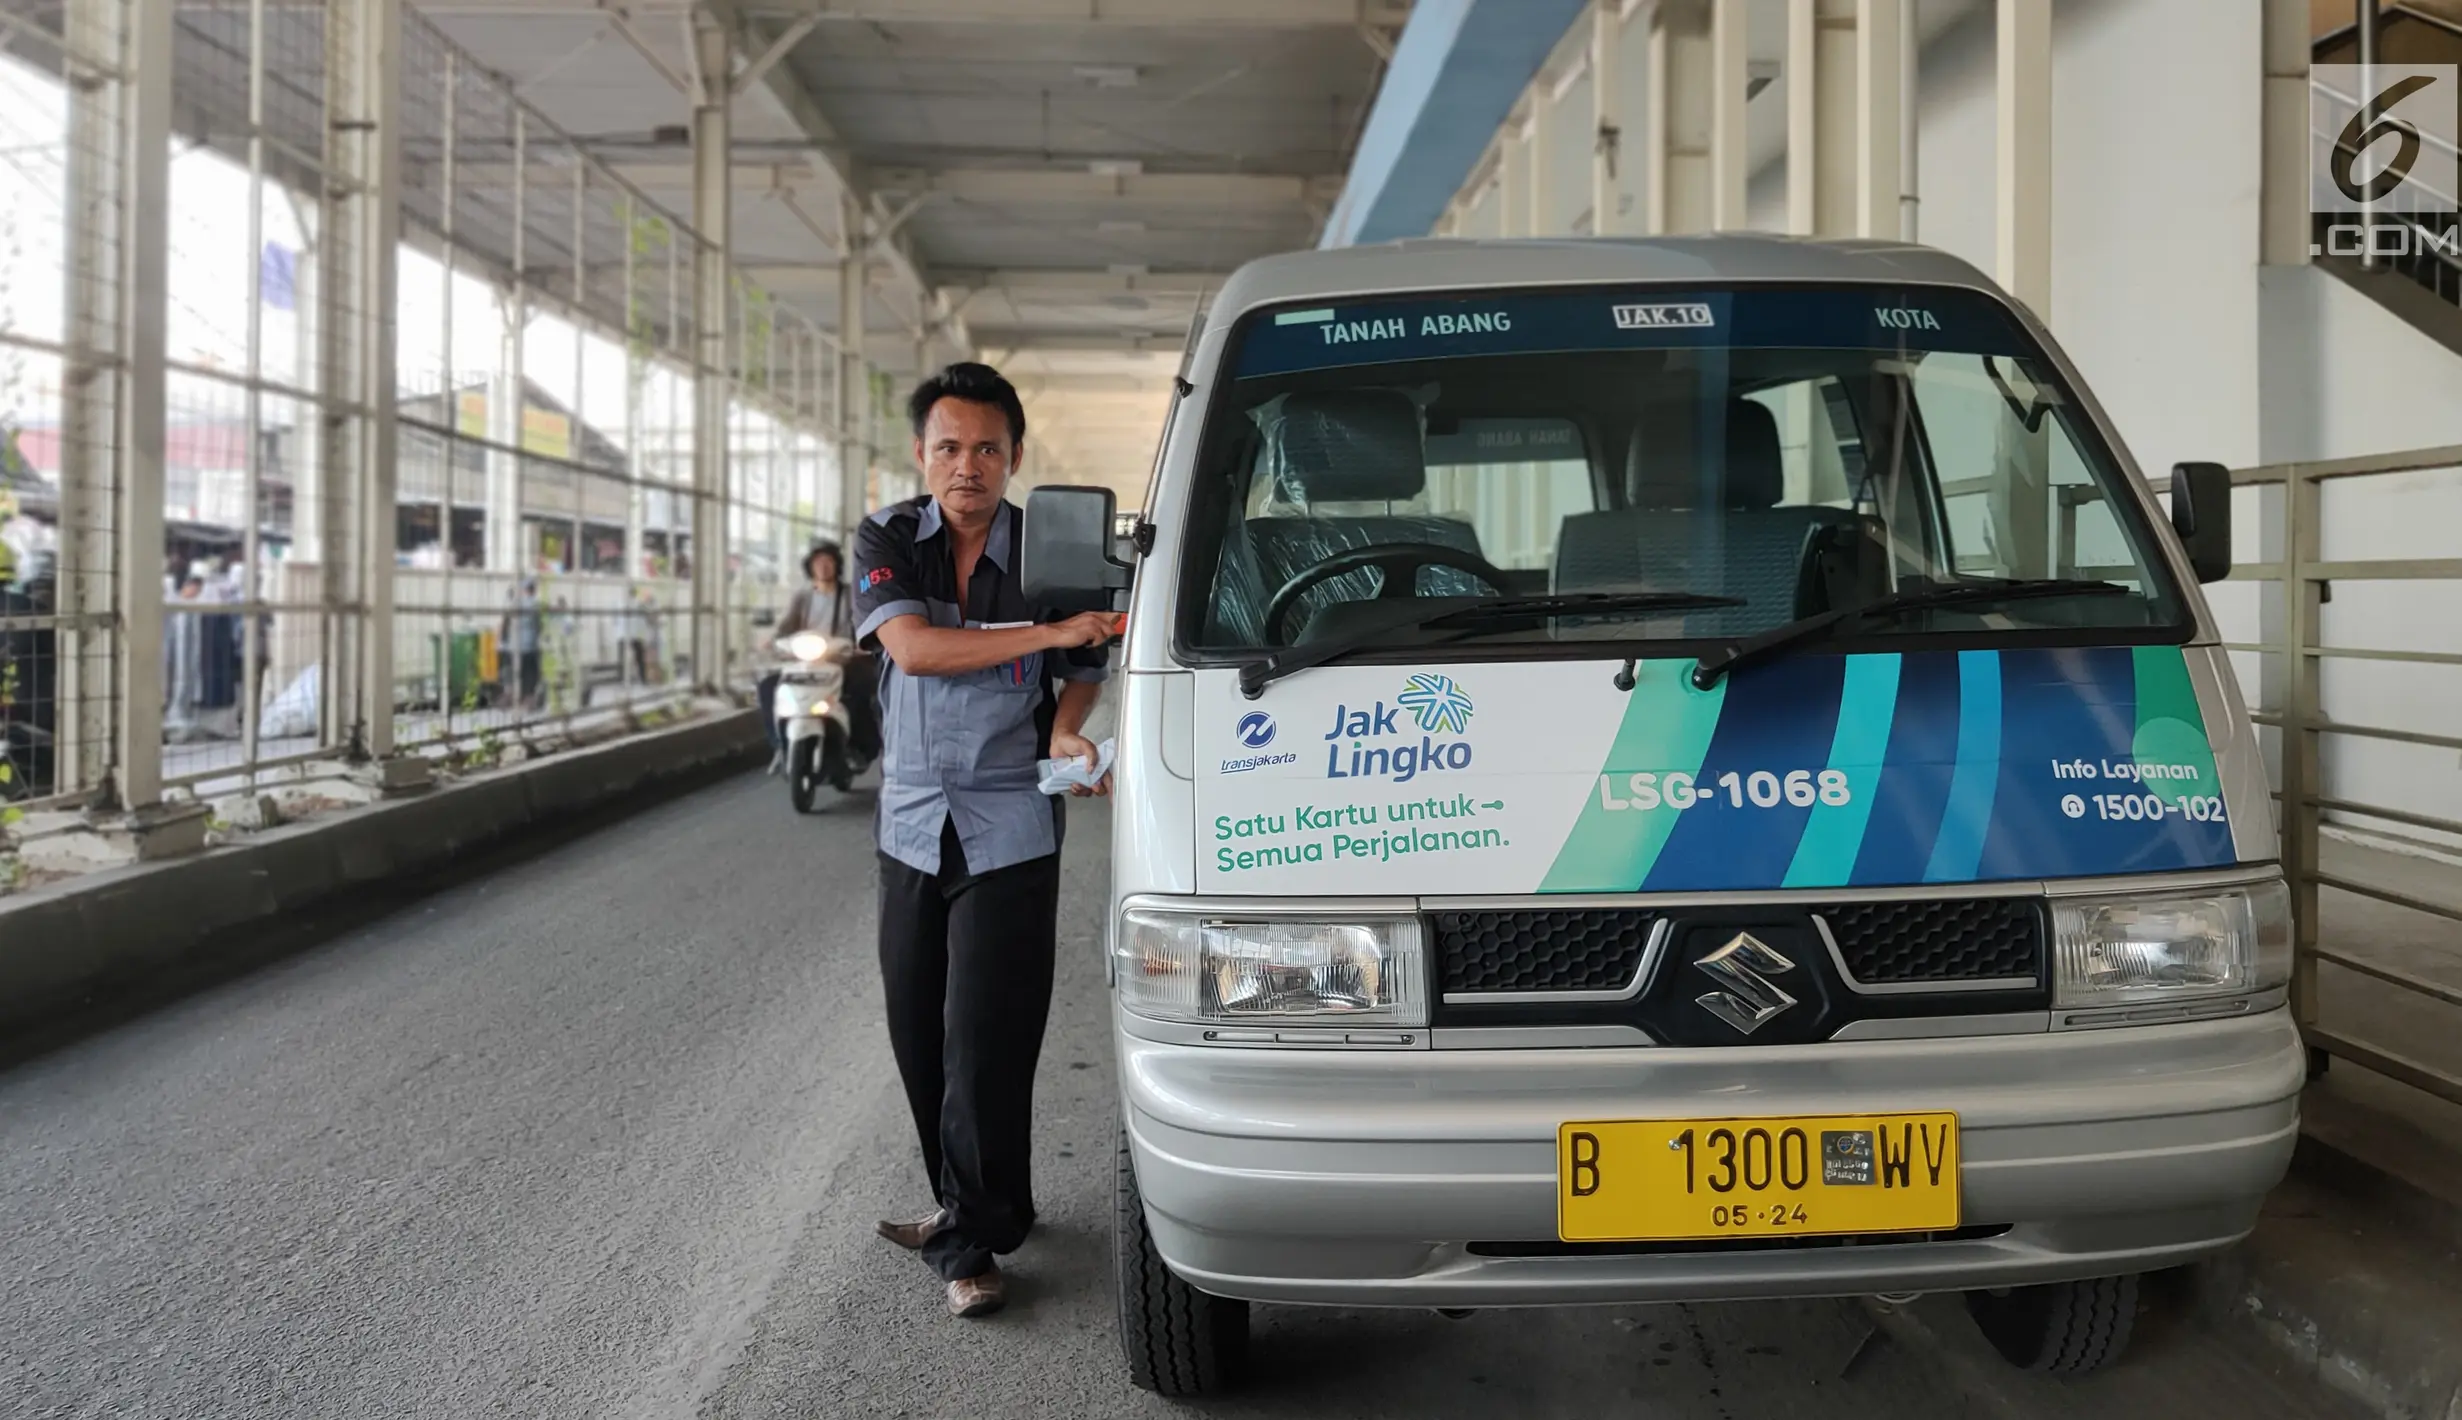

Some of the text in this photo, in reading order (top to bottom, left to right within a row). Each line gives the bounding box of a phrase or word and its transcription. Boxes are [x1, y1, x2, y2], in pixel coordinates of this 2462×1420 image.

[1320, 311, 1511, 344] TANAH ABANG
[1620, 307, 1708, 324] JAK.10
[1875, 306, 1941, 331] KOTA
[1325, 701, 1399, 740] Jak
[1220, 752, 1297, 774] transjakarta
[1327, 735, 1473, 782] Lingko
[2052, 758, 2199, 783] Info Layanan
[1599, 769, 1852, 812] LSG-1068
[2092, 793, 2225, 822] 1500-102
[1215, 793, 1476, 840] Satu Kartu untuk
[1217, 826, 1510, 872] Semua Perjalanan.
[1570, 1123, 1948, 1197] B 1300 WV
